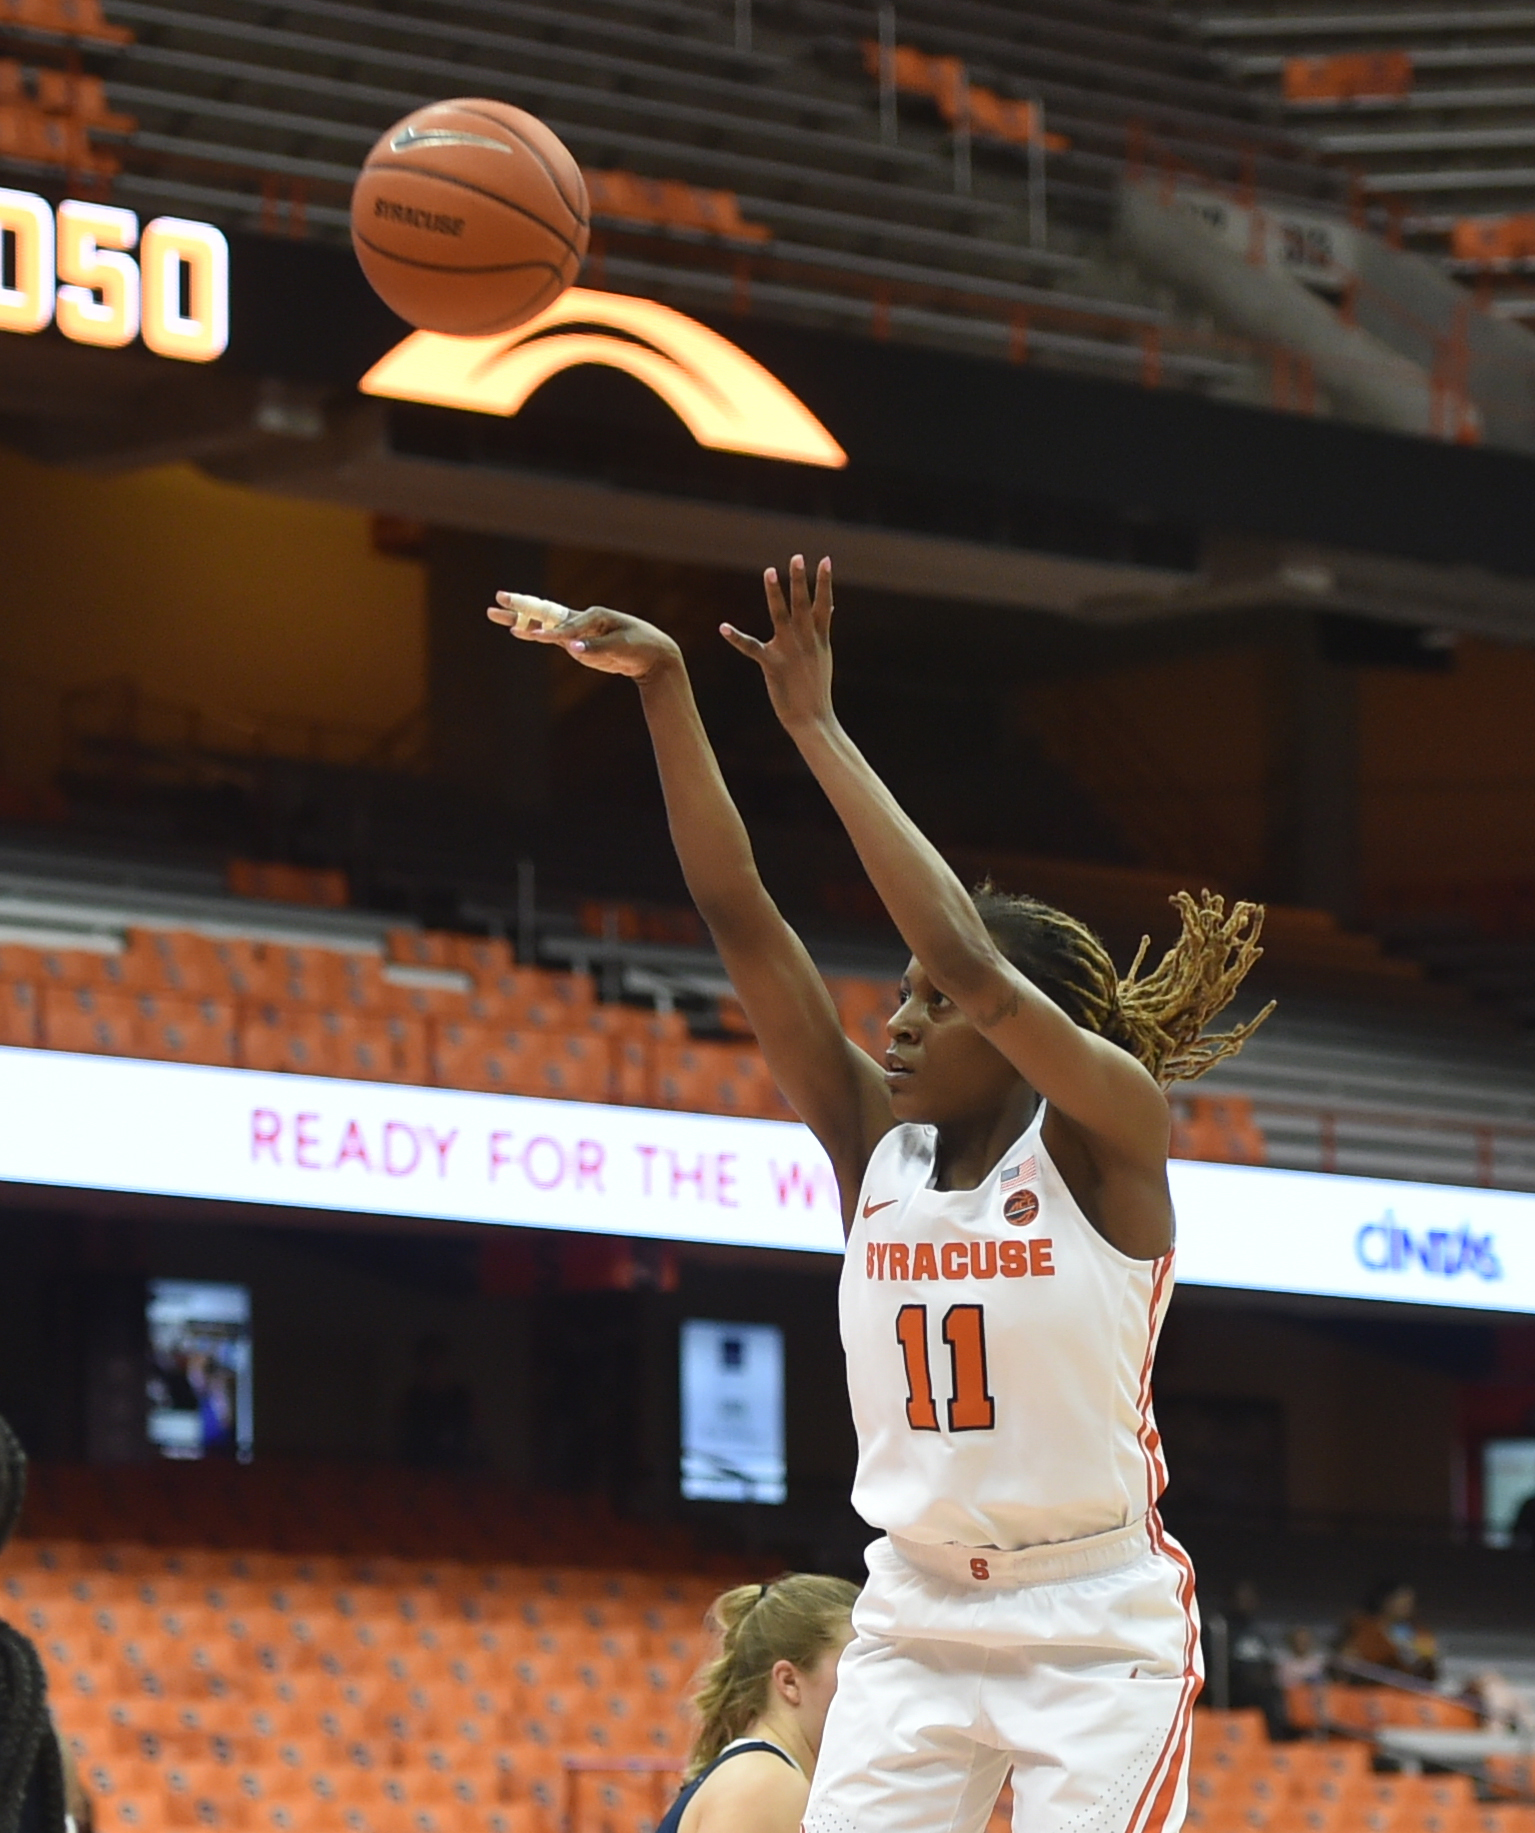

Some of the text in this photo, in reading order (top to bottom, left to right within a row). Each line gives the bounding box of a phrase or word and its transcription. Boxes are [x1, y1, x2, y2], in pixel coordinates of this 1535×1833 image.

[374, 197, 466, 237] SYRACUSE
[250, 1106, 458, 1180] READY
[488, 1130, 606, 1195] FOR
[636, 1144, 741, 1208] THE
[895, 1303, 996, 1433] 11
[969, 1557, 990, 1580] S
